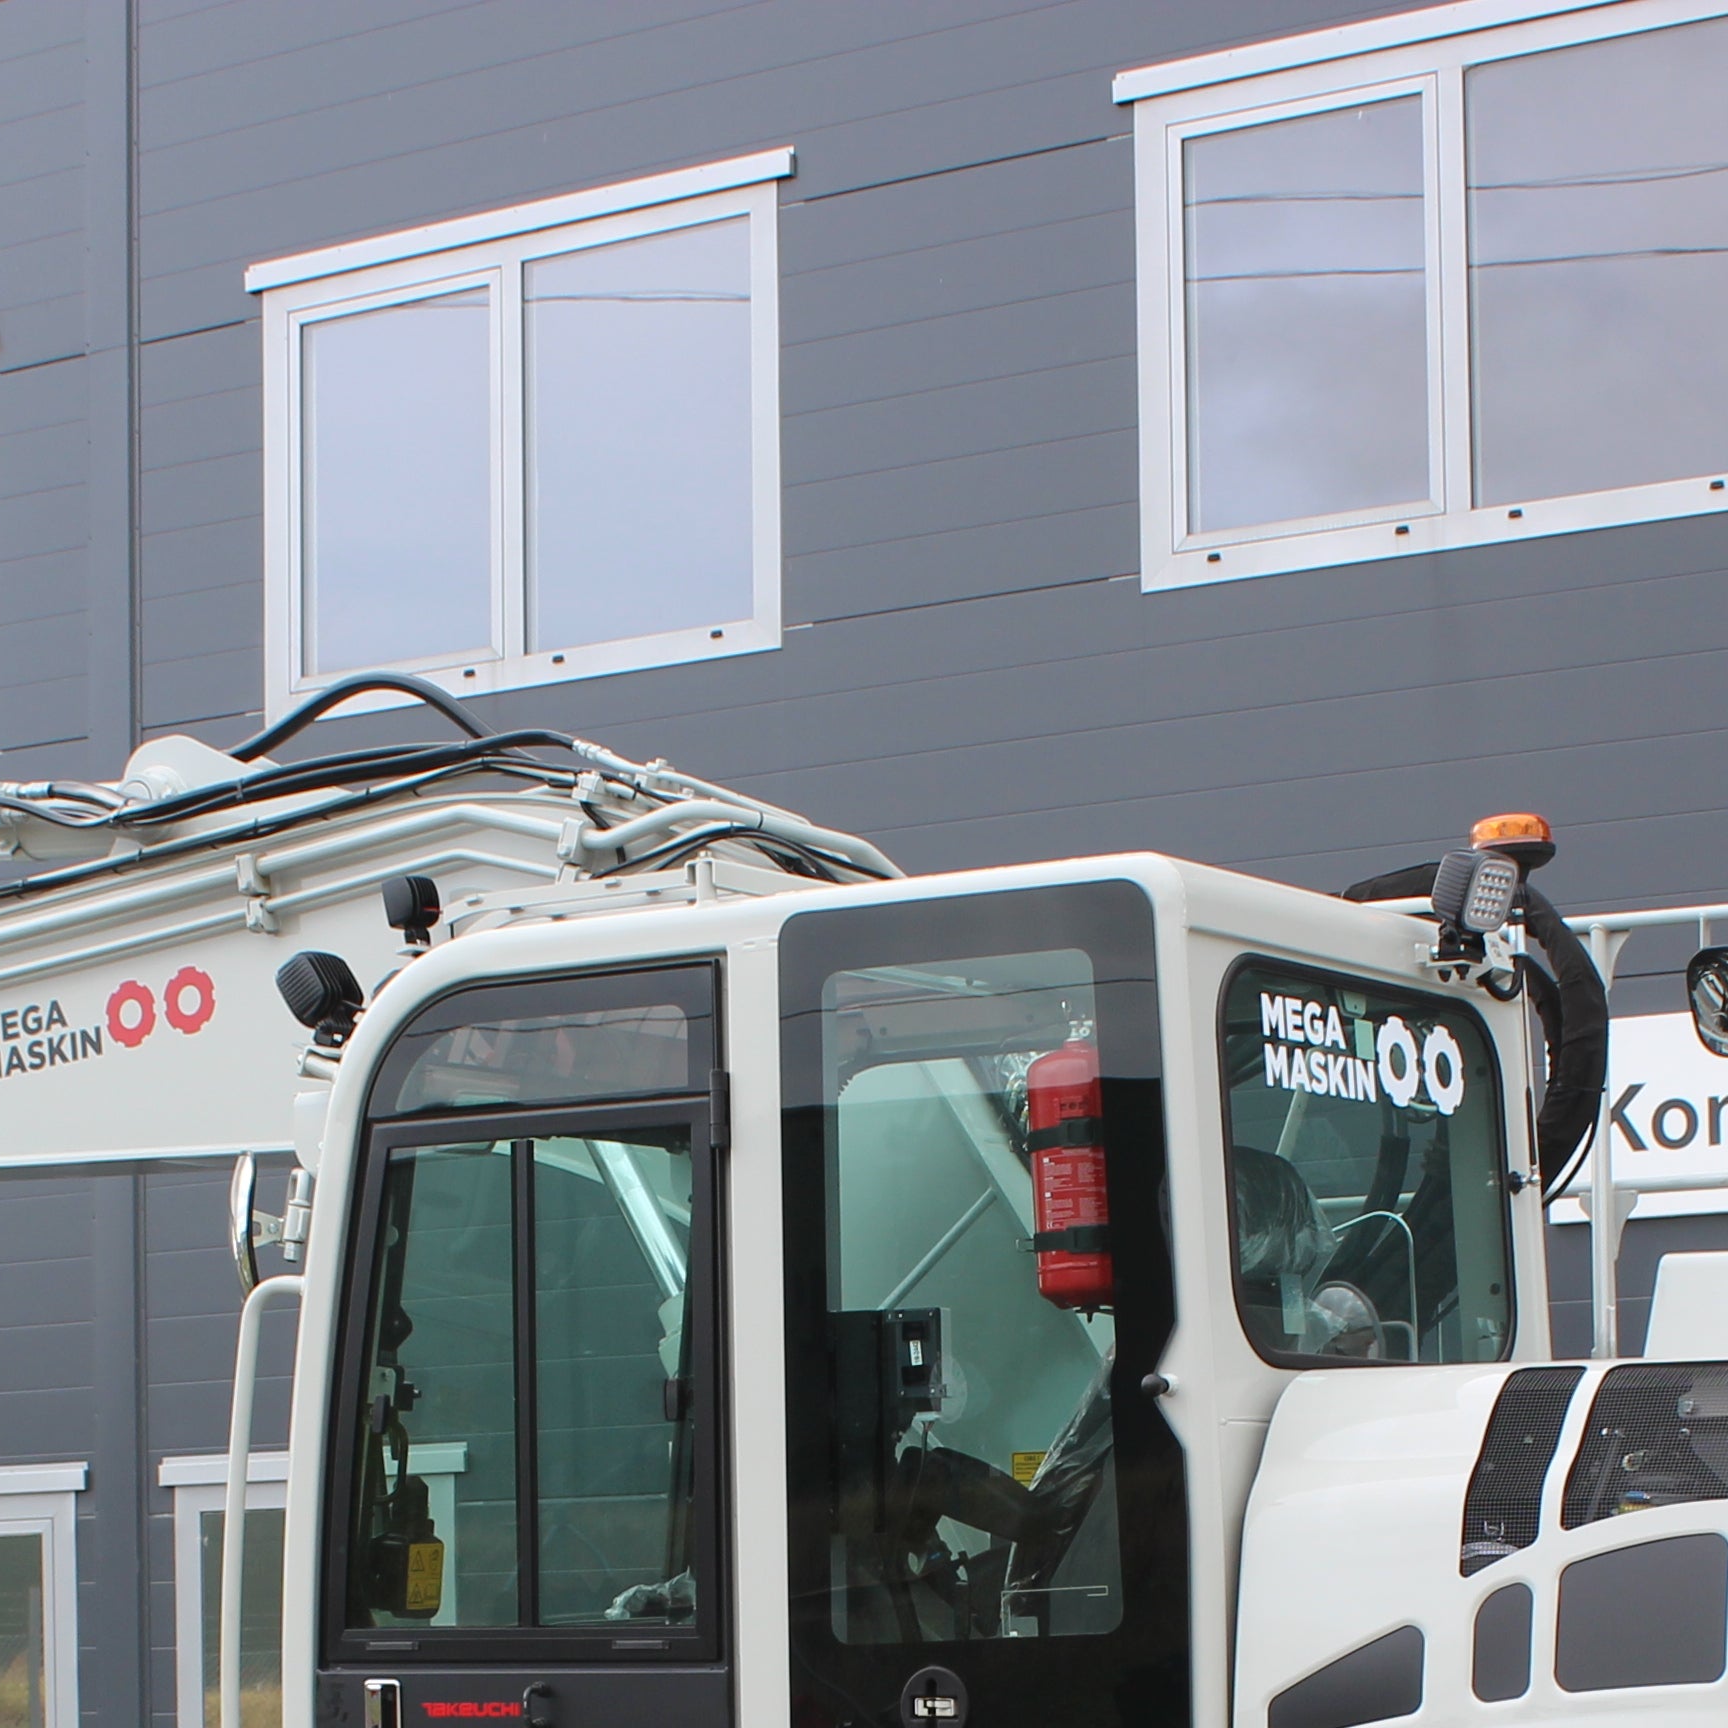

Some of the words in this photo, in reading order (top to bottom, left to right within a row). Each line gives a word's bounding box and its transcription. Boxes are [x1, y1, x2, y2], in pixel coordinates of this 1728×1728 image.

[1260, 992, 1347, 1050] MEGA
[1264, 1043, 1377, 1103] MASKIN
[421, 1702, 521, 1717] TAKEUCHI
